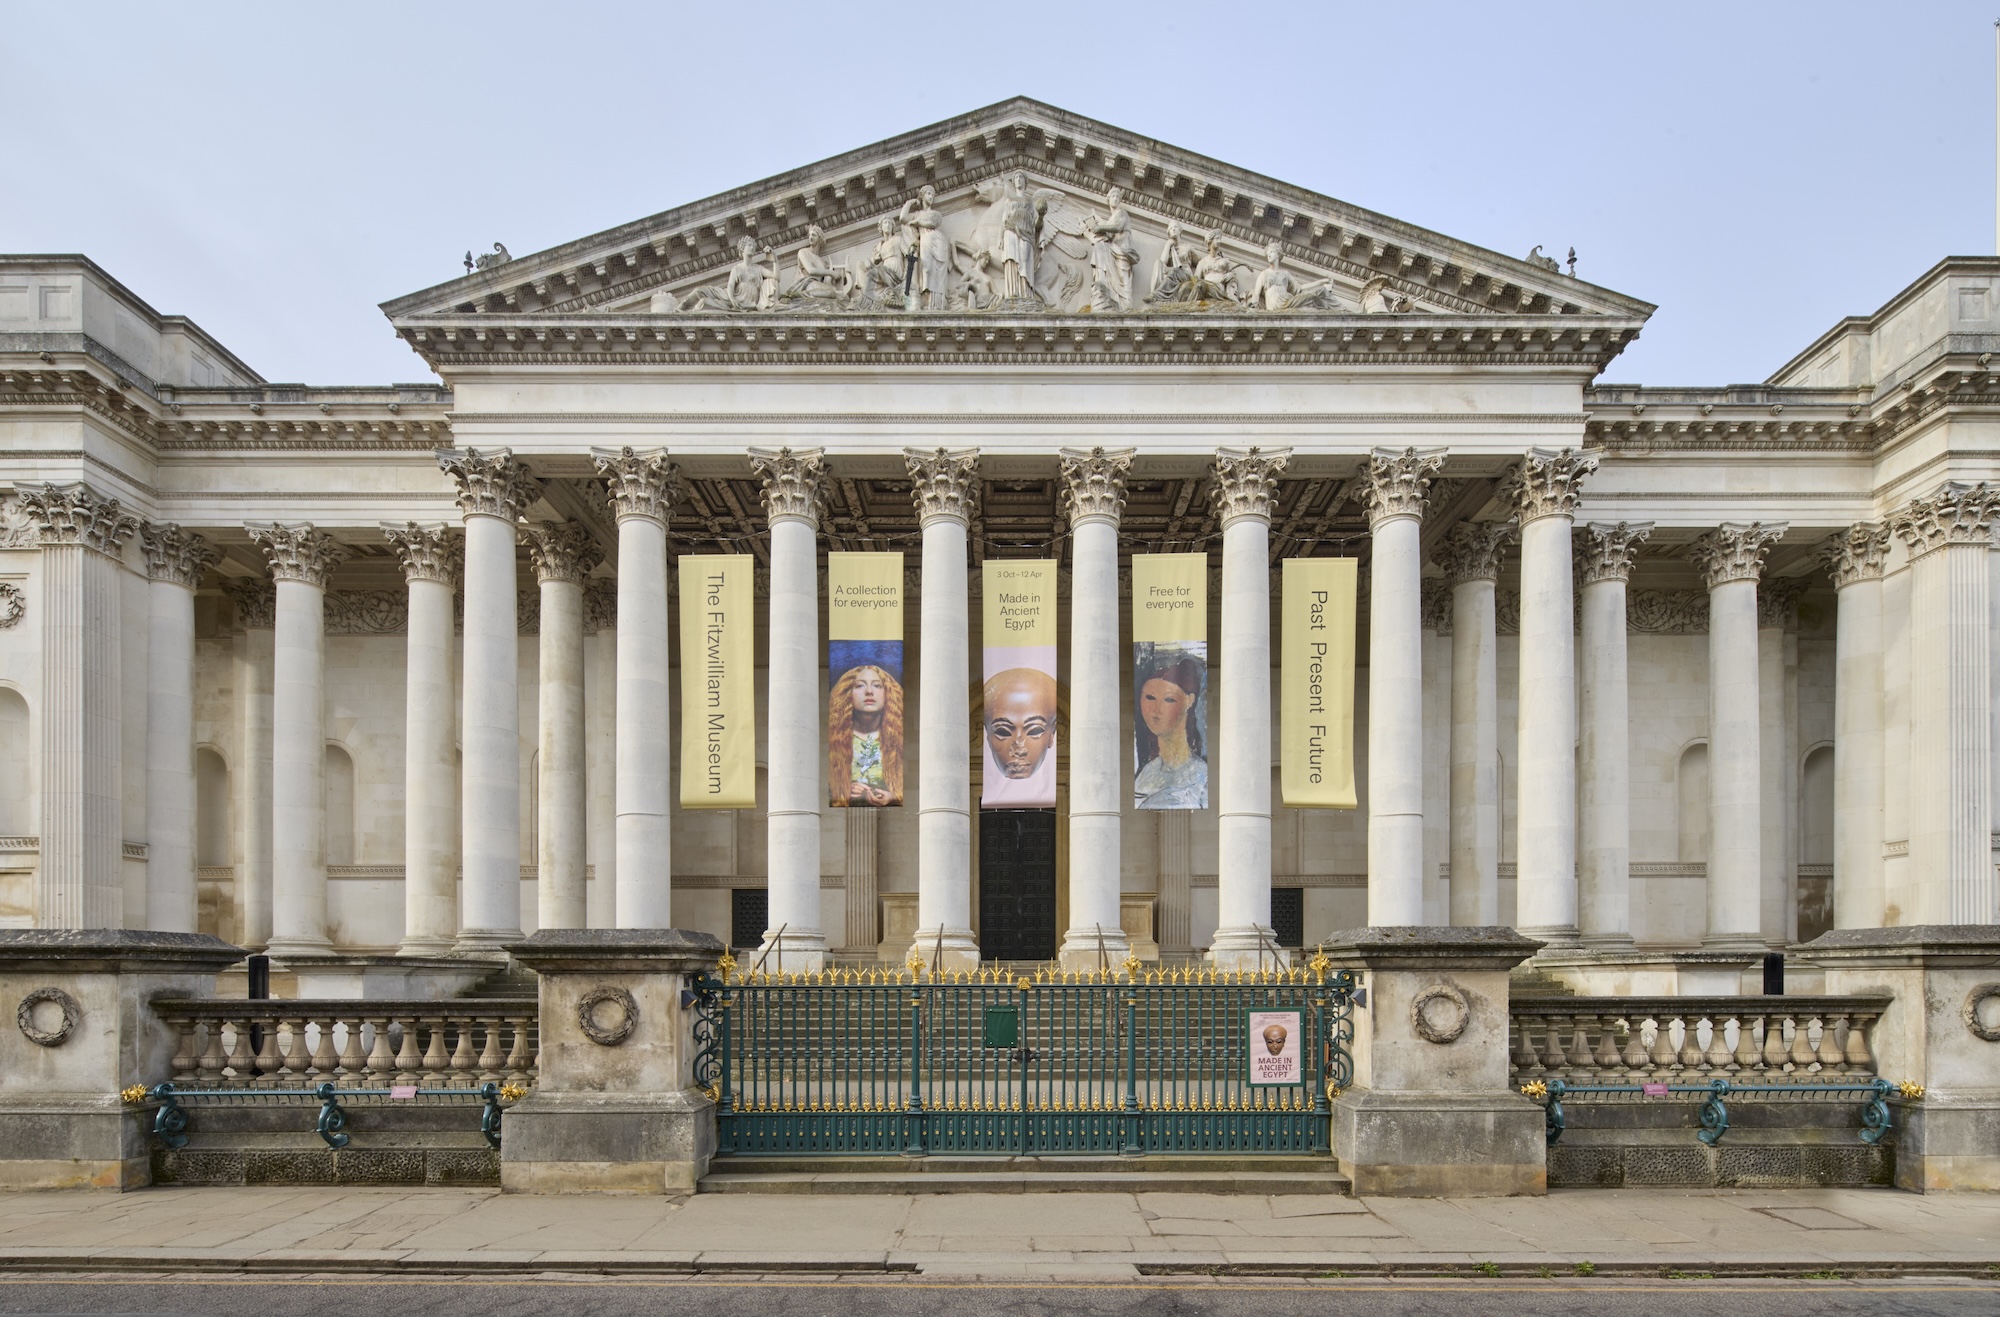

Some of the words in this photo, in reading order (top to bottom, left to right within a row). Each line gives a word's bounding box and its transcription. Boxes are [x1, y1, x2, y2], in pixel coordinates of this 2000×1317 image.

[997, 570, 1002, 578] 3
[1030, 571, 1043, 579] Apr
[707, 571, 725, 606] The
[835, 585, 844, 595] A
[846, 585, 897, 595] collection
[1149, 585, 1173, 597] Free
[1175, 585, 1191, 597] for
[834, 597, 849, 607] for
[851, 599, 899, 610] everyone
[999, 593, 1029, 603] Made
[1031, 593, 1041, 603] in
[999, 605, 1040, 616] Ancient
[1145, 600, 1195, 611] everyone
[1310, 590, 1329, 631] Past
[1005, 618, 1035, 631] Egypt
[707, 611, 725, 708] Fitzwilliam
[1310, 642, 1328, 714] Present
[707, 713, 726, 794] Museum
[1310, 725, 1328, 784] Future
